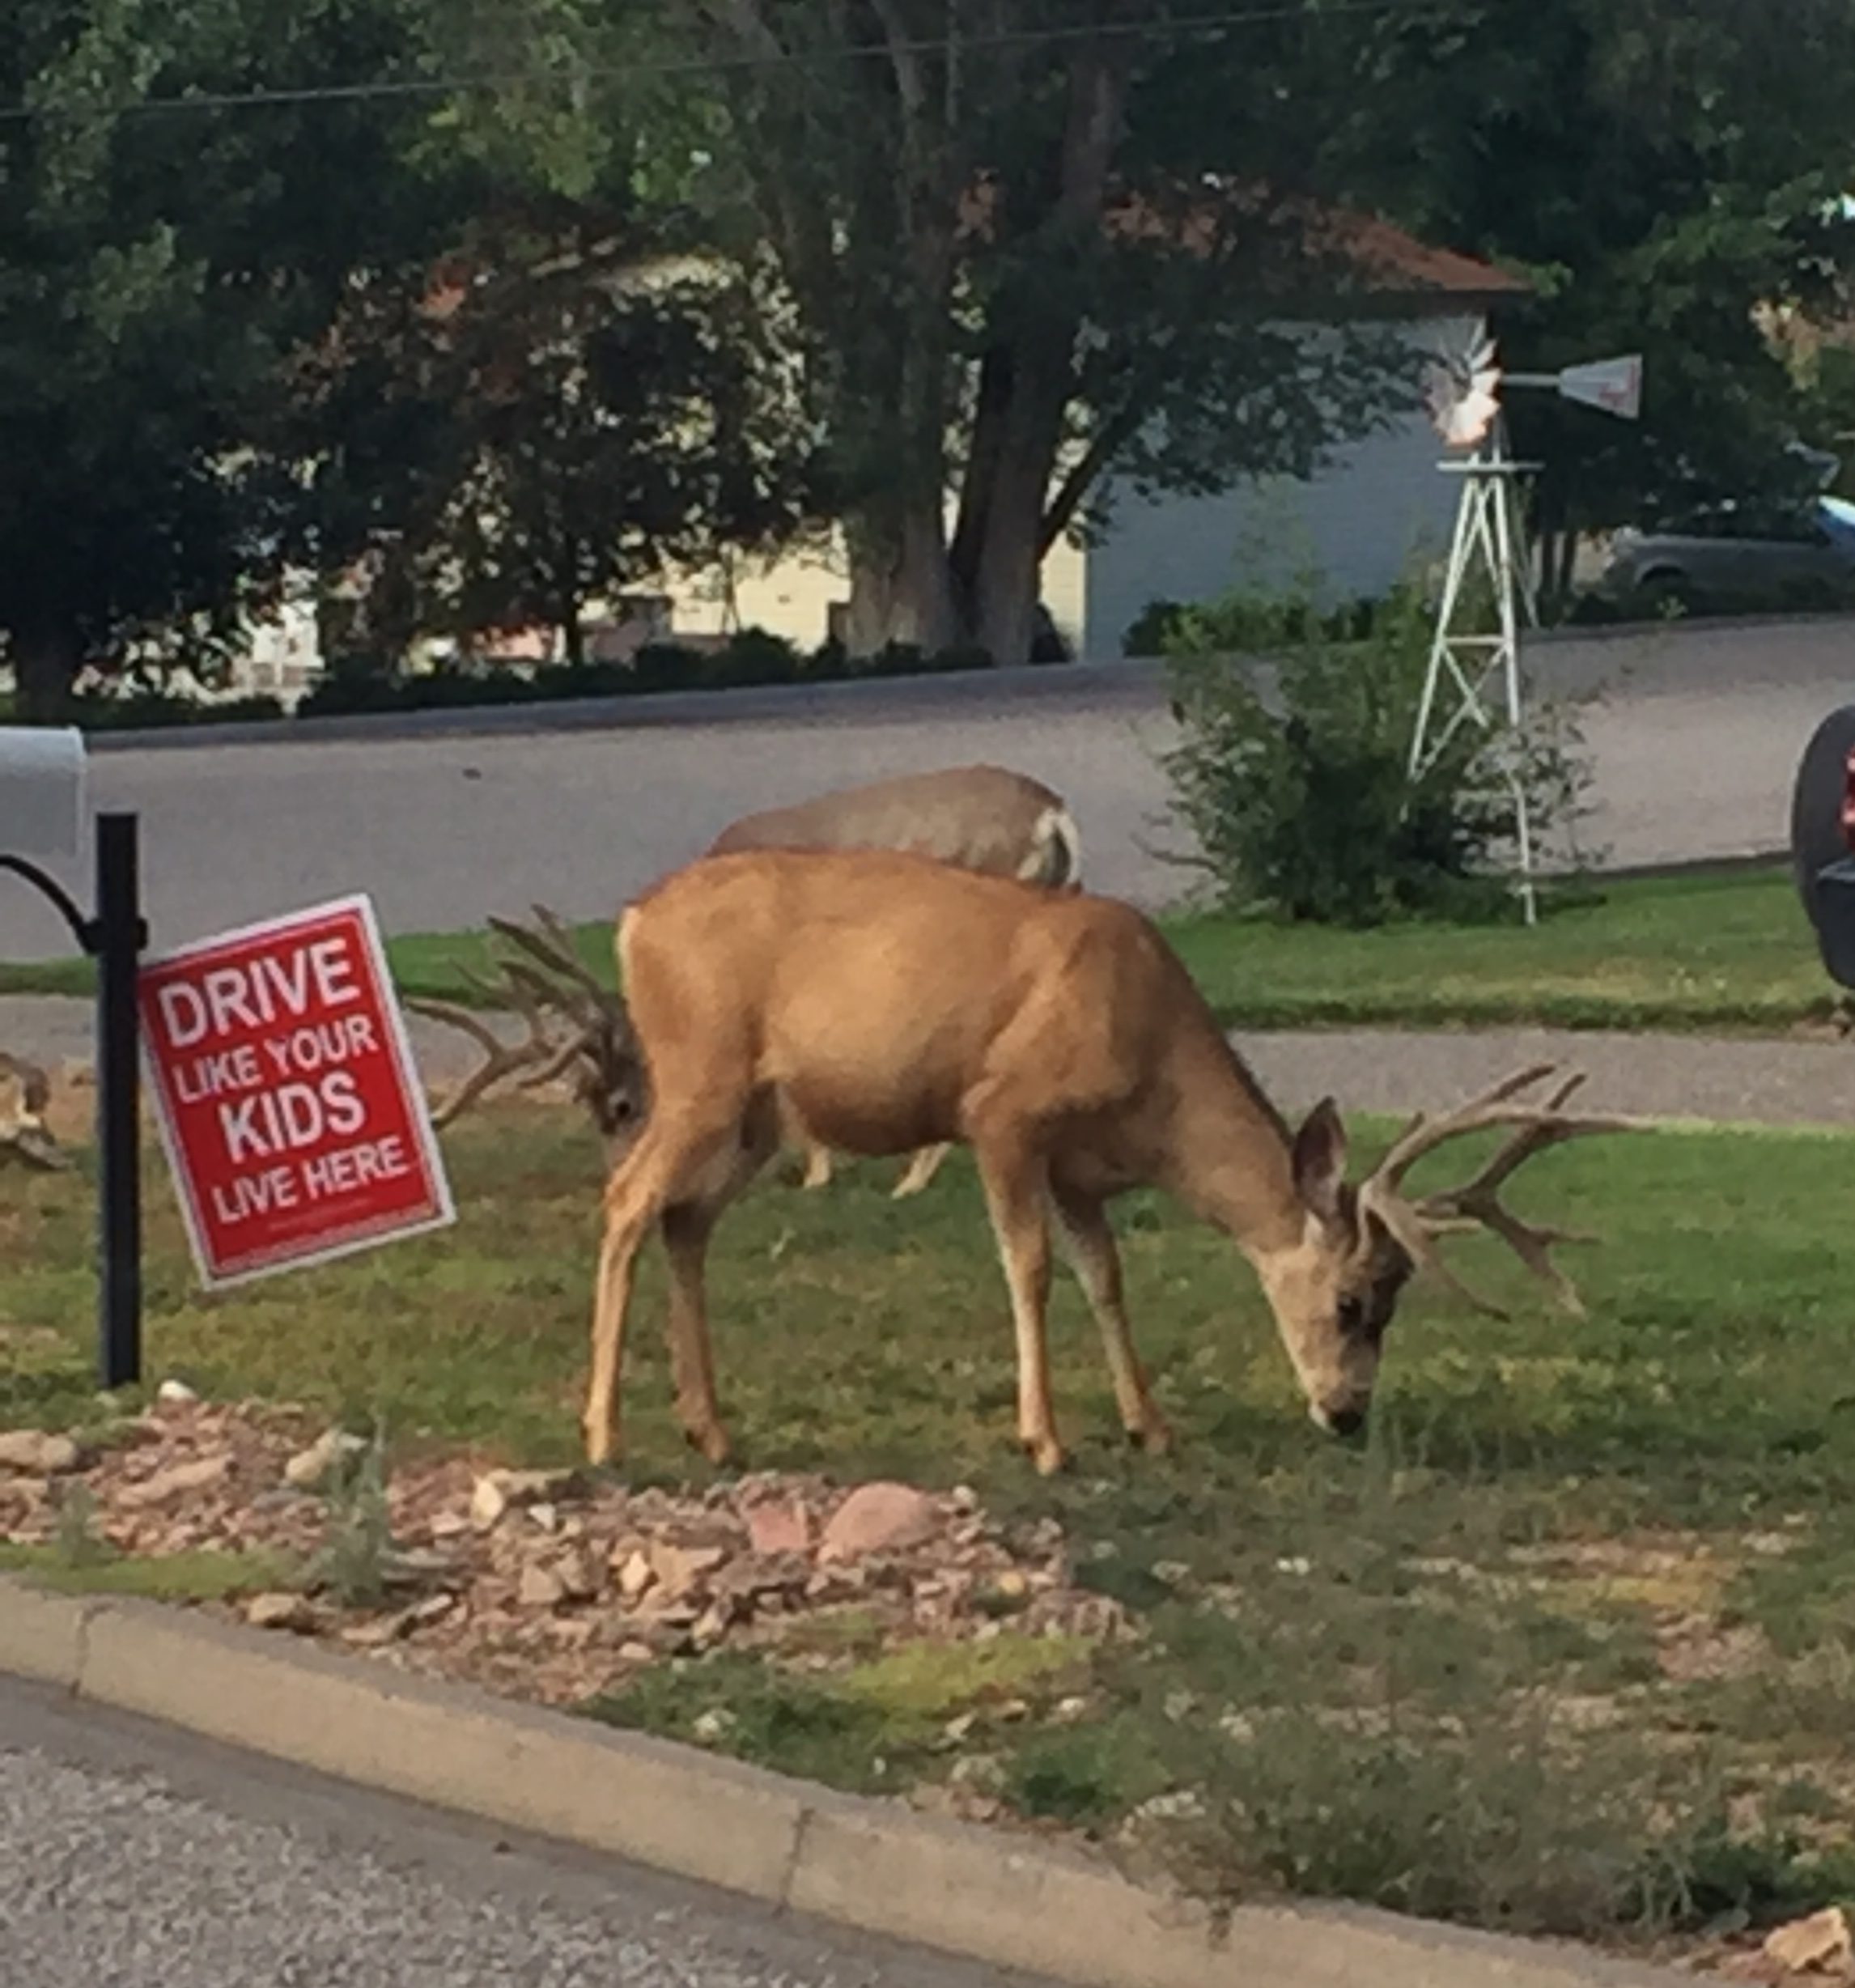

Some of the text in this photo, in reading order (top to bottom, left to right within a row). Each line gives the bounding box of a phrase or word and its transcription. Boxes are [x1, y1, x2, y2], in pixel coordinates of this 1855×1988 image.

[158, 938, 360, 1047] DRIVE
[172, 1014, 379, 1103] LIKE YOUR
[219, 1070, 366, 1163] KIDS
[213, 1166, 299, 1223] LIVE
[303, 1136, 409, 1200] HERE
